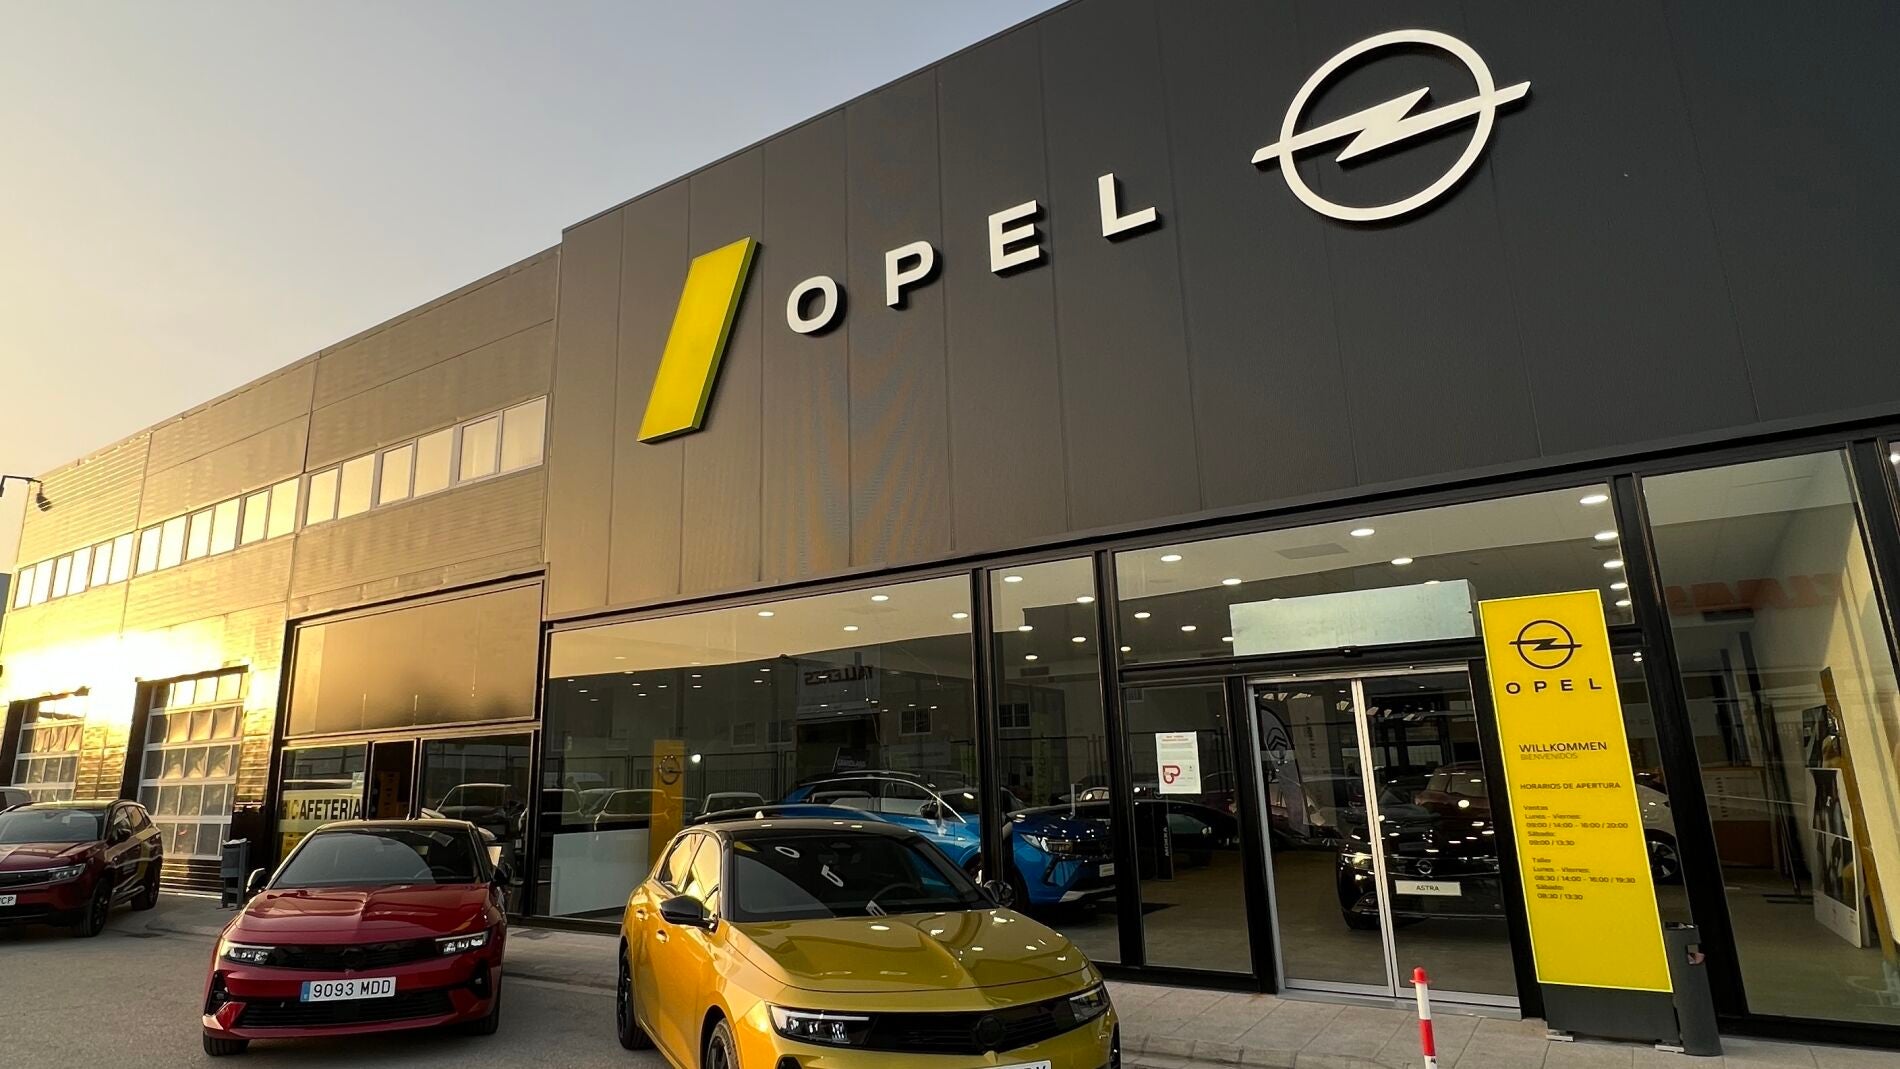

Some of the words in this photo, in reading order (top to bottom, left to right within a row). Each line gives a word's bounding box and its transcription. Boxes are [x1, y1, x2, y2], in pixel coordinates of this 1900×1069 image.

[787, 172, 1158, 335] OPEL
[1505, 678, 1603, 695] OPEL
[1519, 741, 1608, 753] WILLKOMMEN
[1520, 752, 1579, 761] BIENVENIDOS
[1563, 782, 1574, 790] DE
[1576, 781, 1621, 789] APERTURA
[291, 799, 363, 820] CAFETERIA
[313, 982, 354, 998] 9093
[360, 979, 391, 995] MDD
